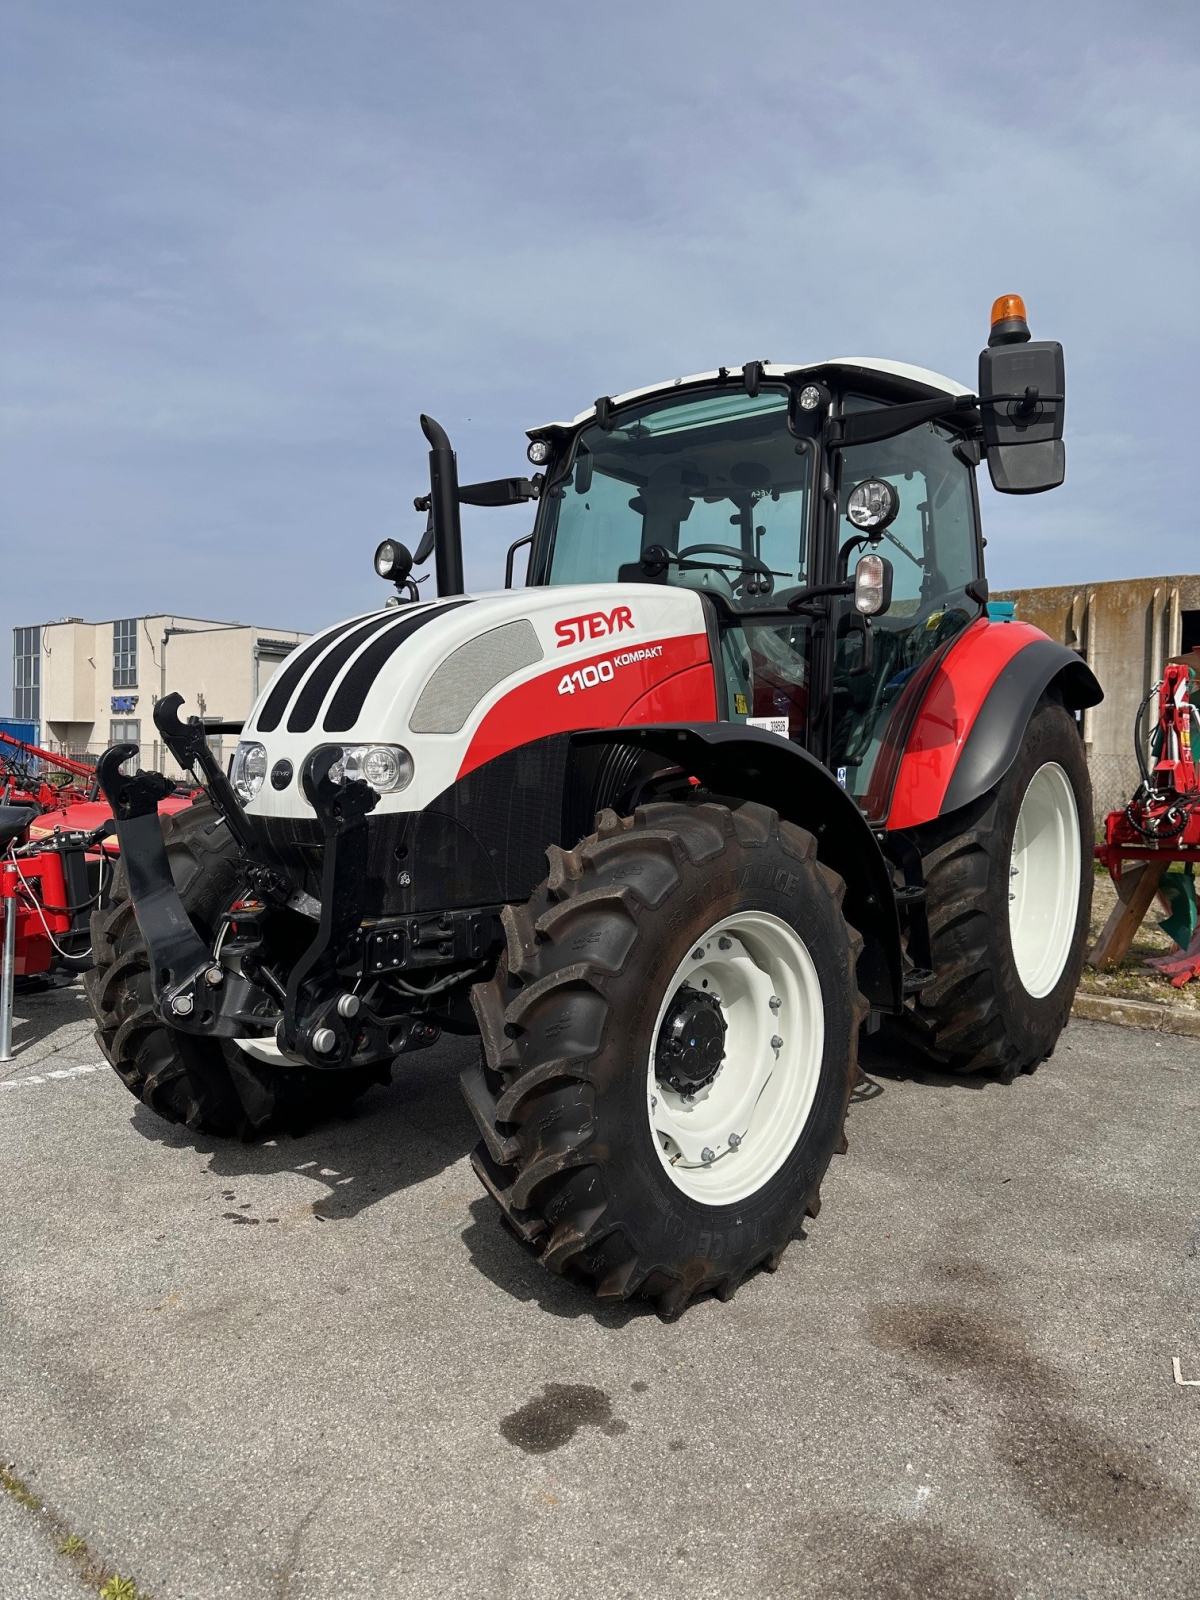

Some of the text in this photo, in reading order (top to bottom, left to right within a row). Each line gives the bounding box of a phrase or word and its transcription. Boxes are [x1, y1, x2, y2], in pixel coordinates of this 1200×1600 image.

[555, 606, 635, 648] STEYR
[557, 646, 663, 695] 4100 KOMPAKT
